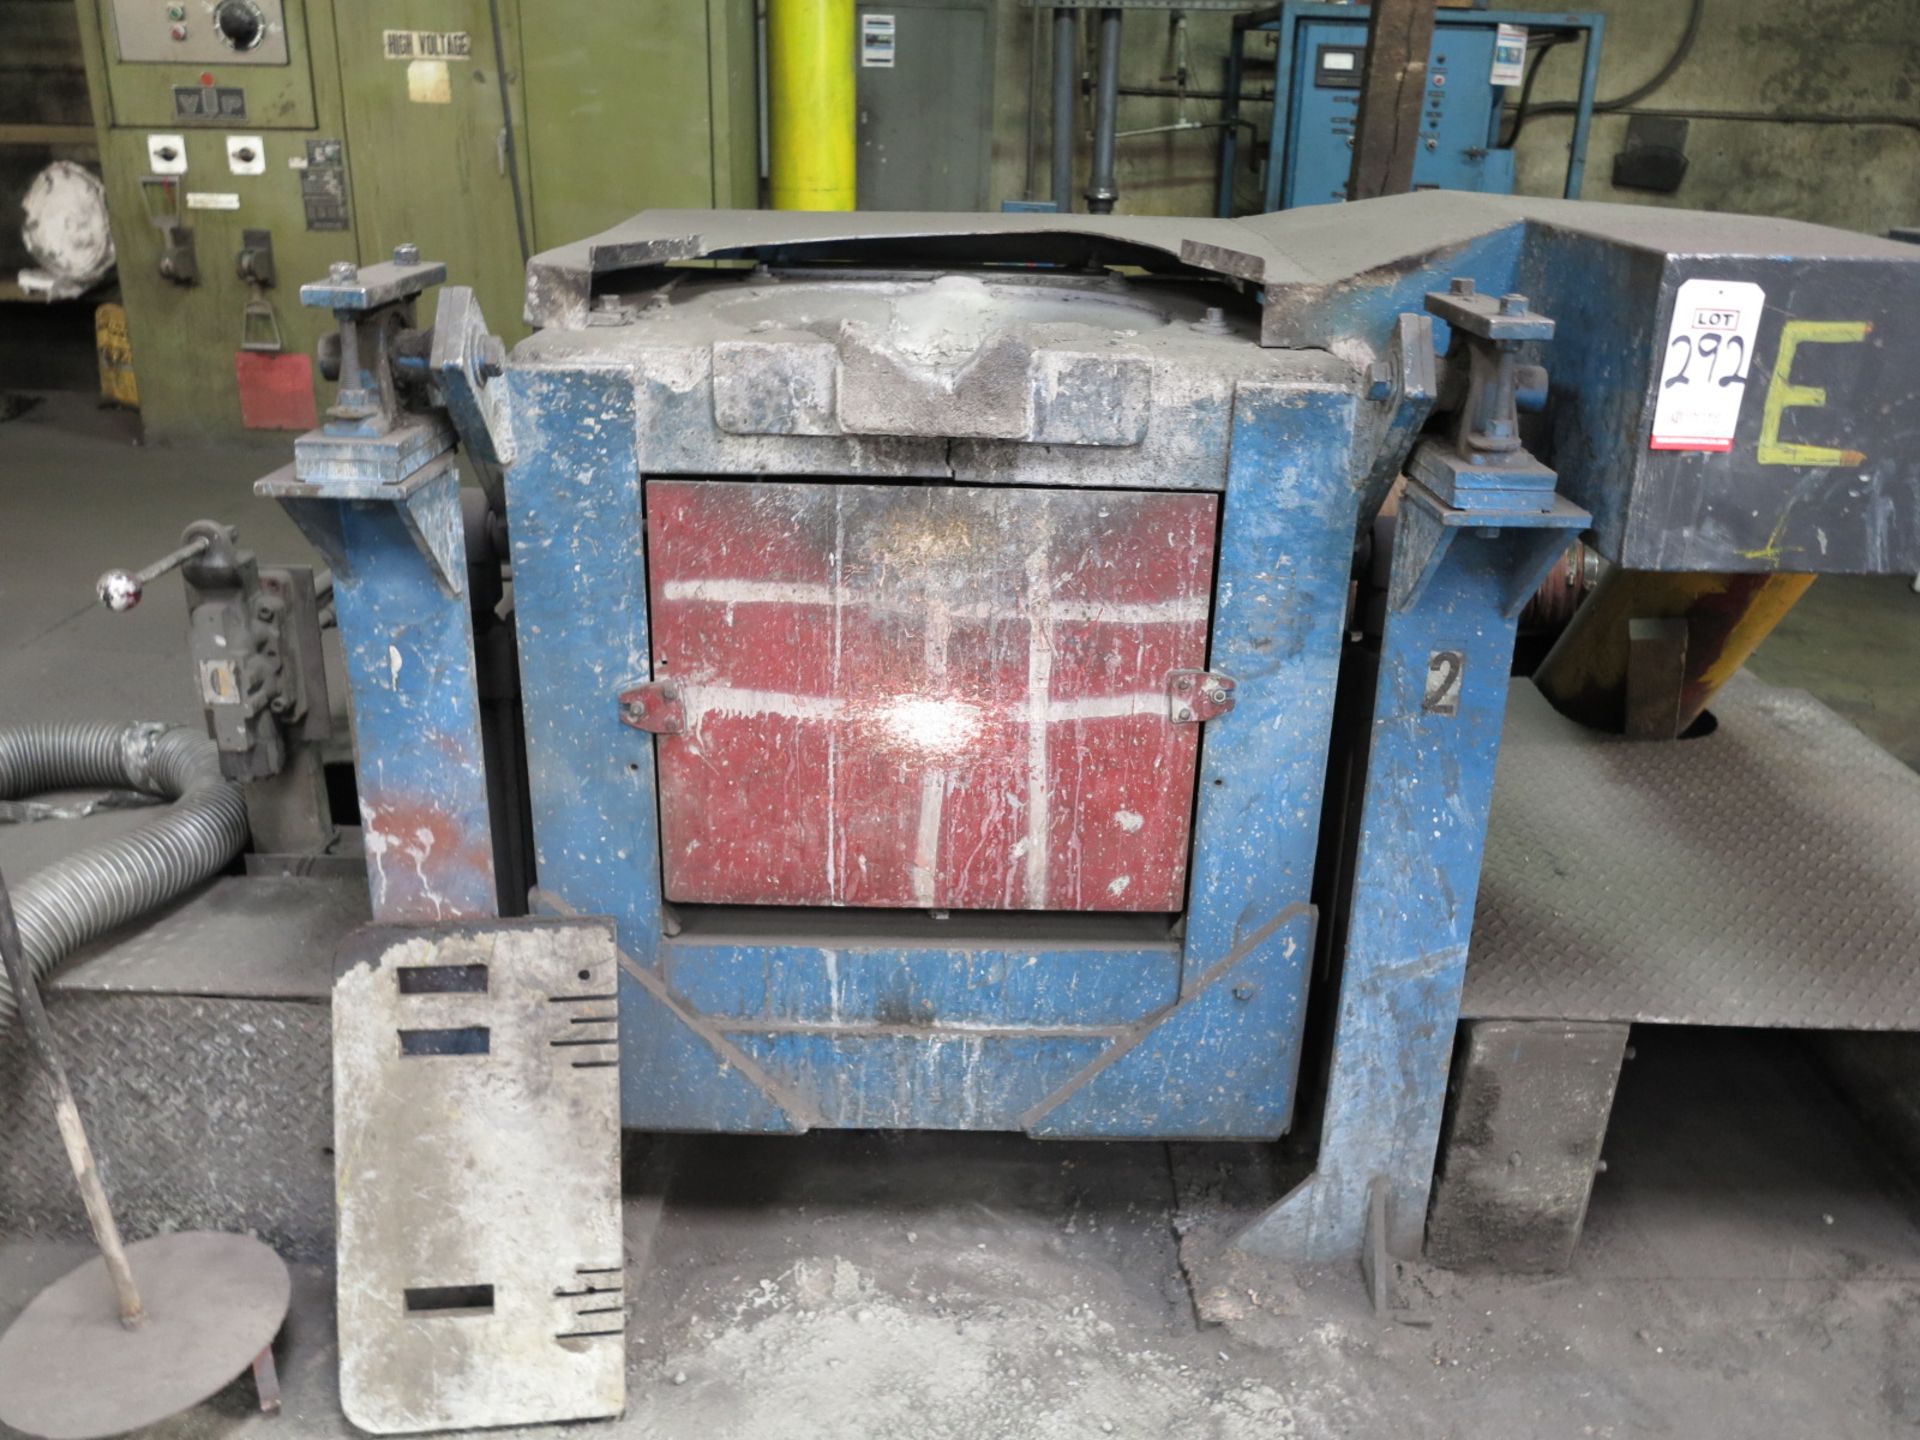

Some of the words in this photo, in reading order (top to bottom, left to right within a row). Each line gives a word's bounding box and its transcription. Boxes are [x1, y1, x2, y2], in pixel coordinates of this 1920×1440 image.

[387, 32, 414, 56] HIGH
[418, 33, 469, 57] VOLTAGE
[1697, 311, 1735, 327] LOT
[1664, 332, 1746, 389] 292
[1757, 320, 1873, 466] E
[1422, 651, 1461, 714] 2
